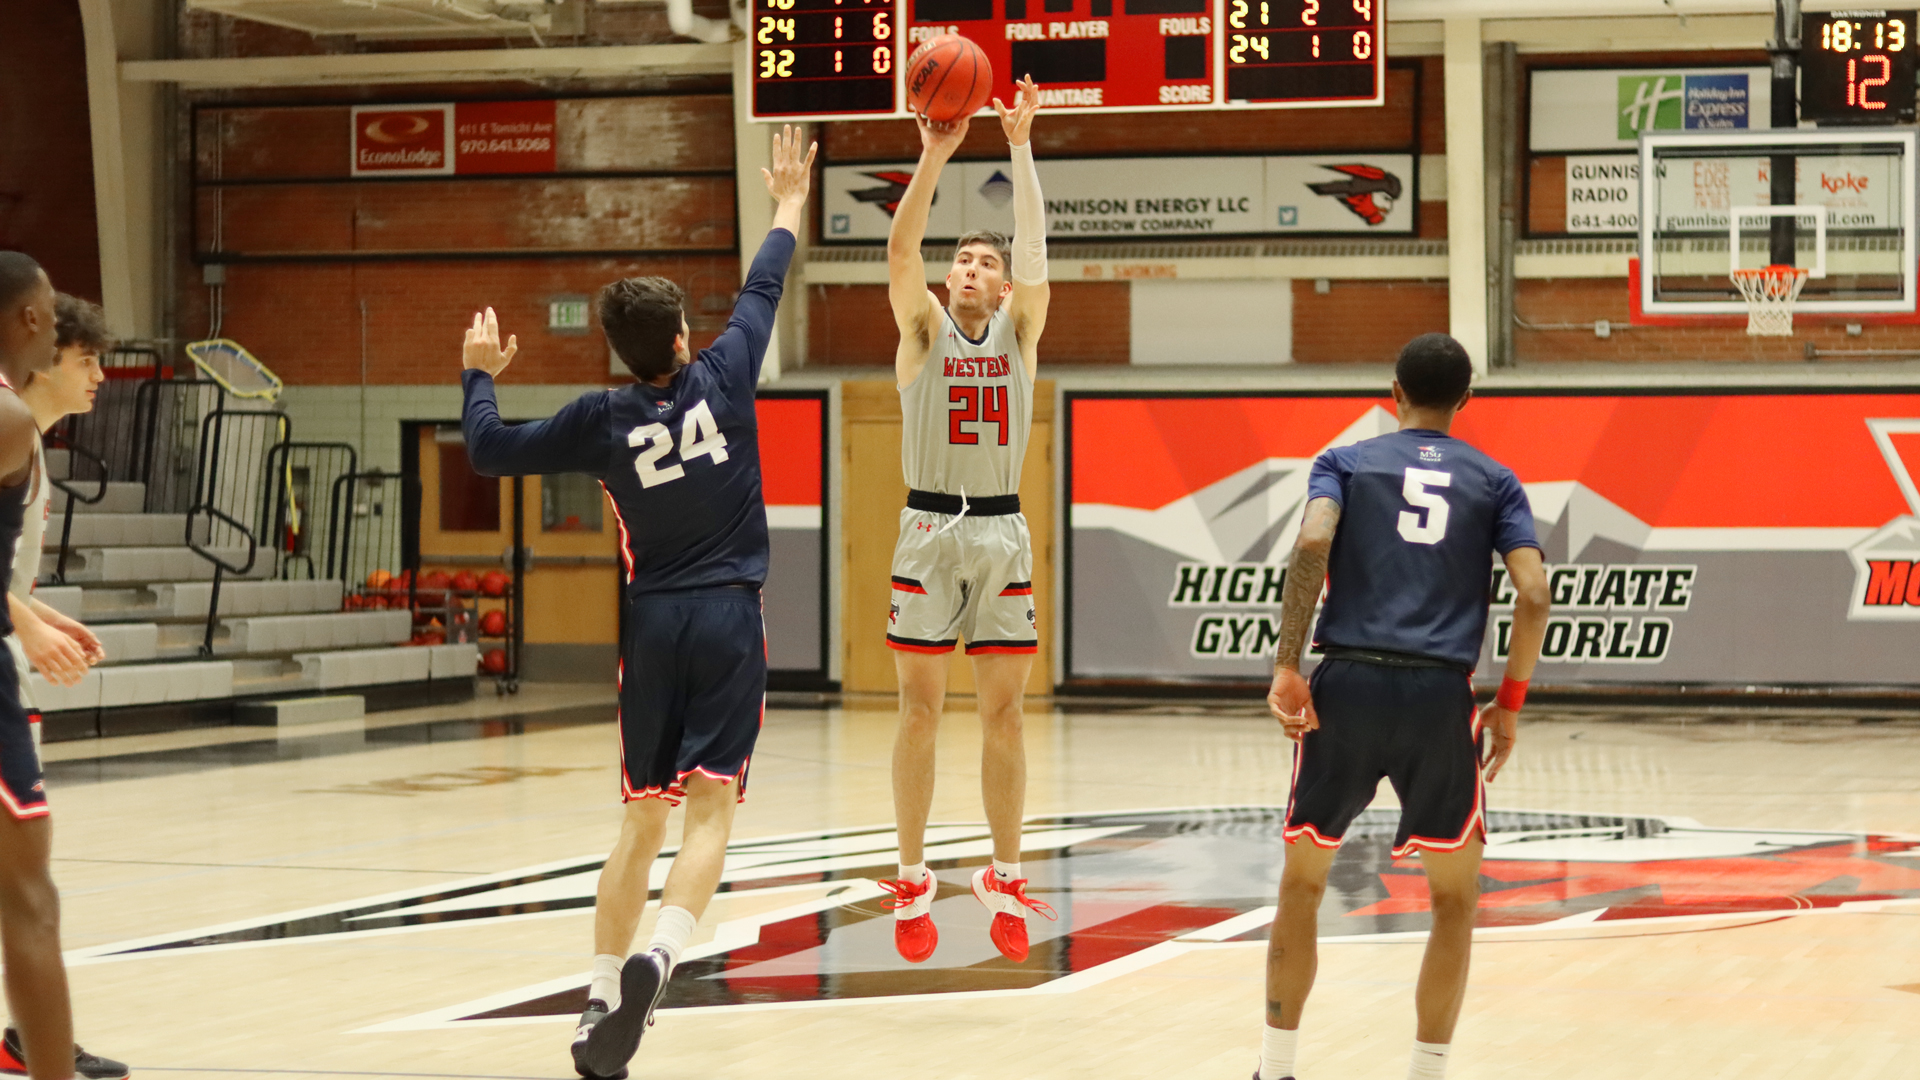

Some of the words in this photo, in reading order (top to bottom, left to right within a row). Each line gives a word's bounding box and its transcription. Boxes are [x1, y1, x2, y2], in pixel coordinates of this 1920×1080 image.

[1229, 0, 1269, 29] 21
[757, 16, 795, 45] 24
[834, 16, 843, 39] 1
[872, 12, 891, 40] 6
[1005, 23, 1046, 40] FOUL
[1049, 21, 1110, 38] PLAYER
[1159, 17, 1211, 35] FOULS
[1822, 19, 1905, 52] 18:13
[1229, 34, 1269, 64] 24
[1311, 34, 1320, 58] 1
[1353, 31, 1371, 60] 0
[759, 49, 795, 78] 32
[834, 50, 843, 73] 1
[872, 46, 891, 74] 0
[911, 58, 939, 98] NCAA
[1846, 54, 1891, 110] 12
[1014, 88, 1103, 106] AVANTAGE
[1159, 85, 1211, 104] SCORE
[1687, 102, 1746, 119] Express
[532, 121, 553, 133] Ave
[460, 138, 551, 154] 970.641.3068
[1571, 164, 1667, 180] GUNNISN
[1571, 187, 1628, 202] RADIO
[1045, 199, 1128, 215] NNISON
[1135, 198, 1210, 214] ENERGY
[1217, 197, 1250, 213] LLC
[1052, 220, 1074, 232] AN
[1079, 219, 1136, 232] OXBOW
[1140, 218, 1214, 231] COMPANY
[1571, 214, 1638, 228] 641-400
[1083, 265, 1103, 278] NO
[1113, 264, 1177, 279] SMOKING
[948, 385, 1009, 446] 24
[628, 399, 729, 489] 24
[1396, 467, 1451, 545] 5
[1172, 566, 1289, 604] HIGH
